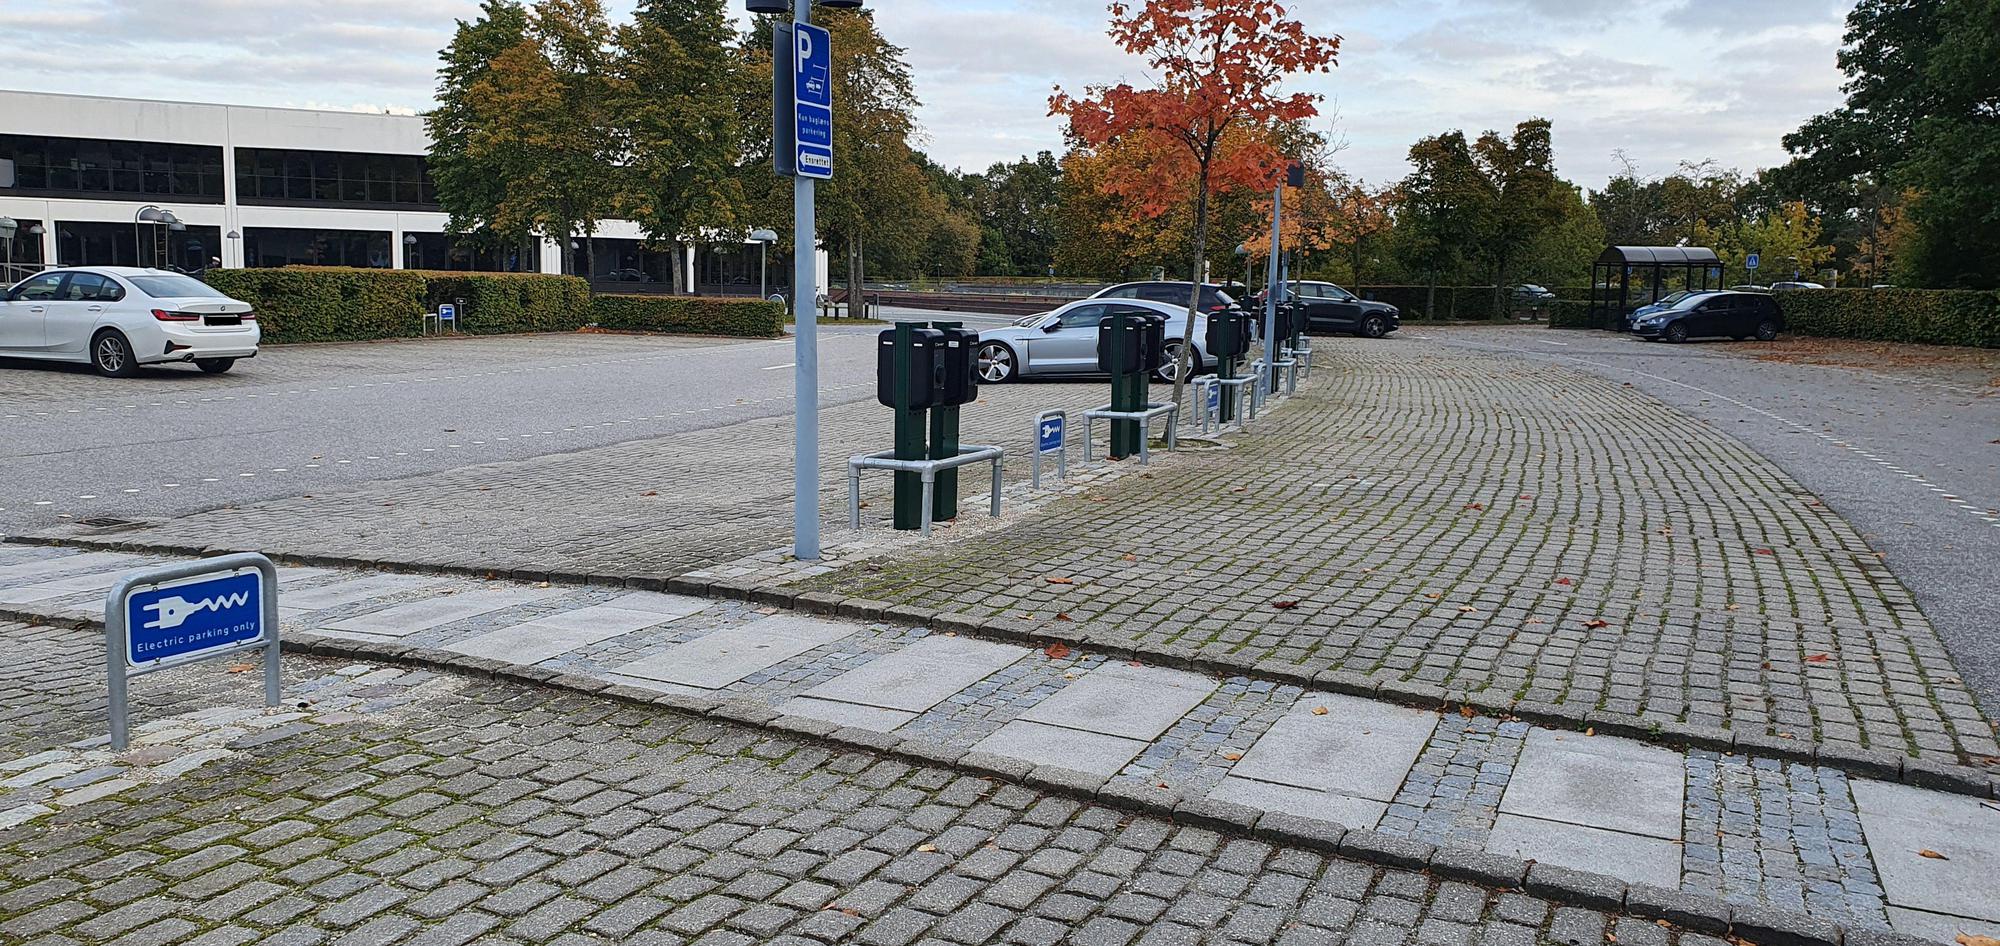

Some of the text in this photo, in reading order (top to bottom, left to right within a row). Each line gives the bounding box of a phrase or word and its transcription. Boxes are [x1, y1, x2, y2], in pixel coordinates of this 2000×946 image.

[798, 30, 812, 73] P
[137, 621, 255, 652] Electric parking only
